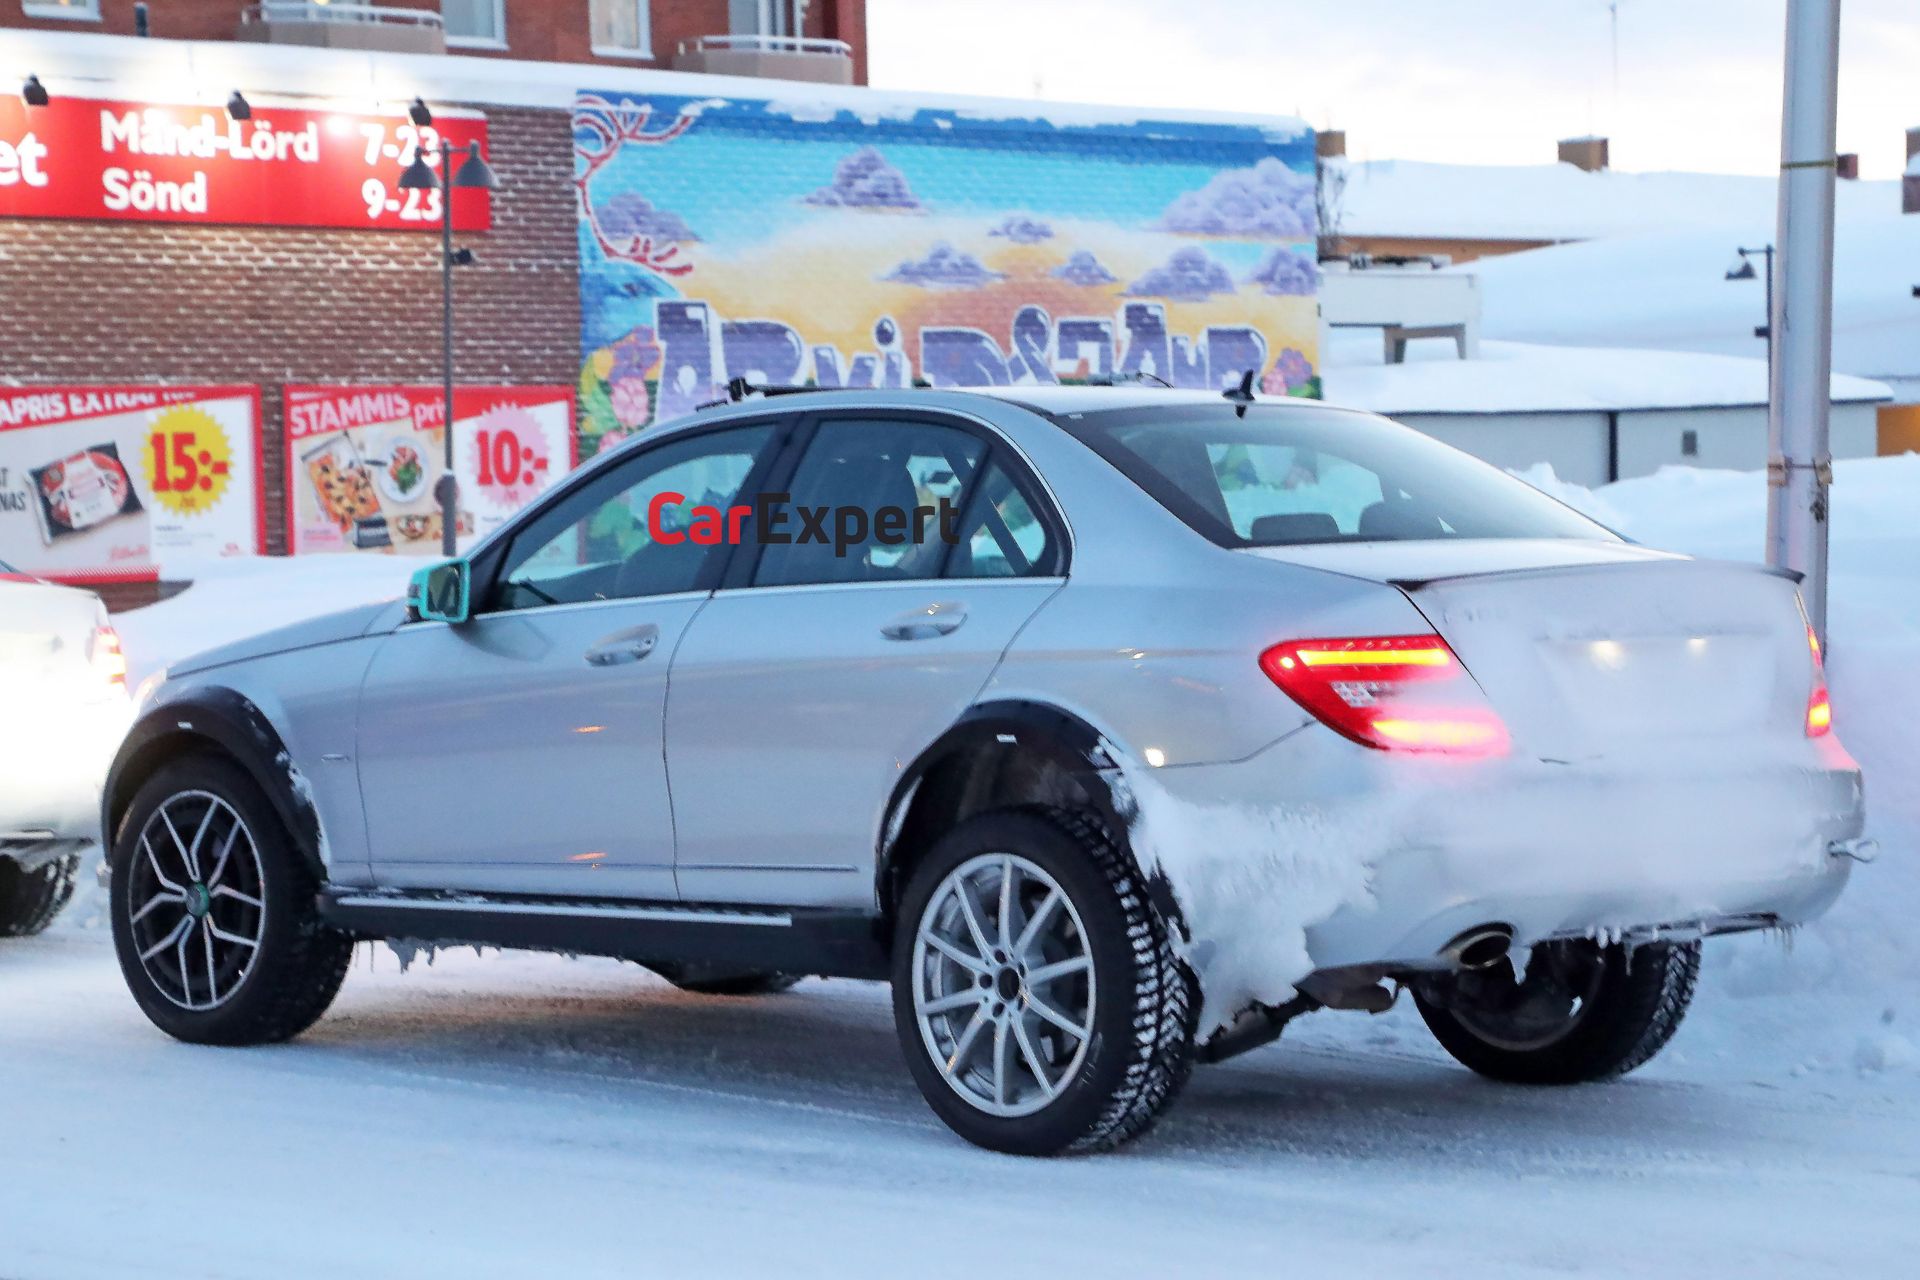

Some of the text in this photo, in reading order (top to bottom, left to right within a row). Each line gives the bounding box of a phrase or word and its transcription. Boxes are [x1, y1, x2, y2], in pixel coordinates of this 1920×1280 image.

[100, 103, 441, 168] Månd-Lörd 7-23
[102, 167, 443, 222] Sönd 9-23
[290, 393, 410, 435] STAMMIS
[151, 432, 229, 492] 15:-
[477, 430, 549, 486] 10:-
